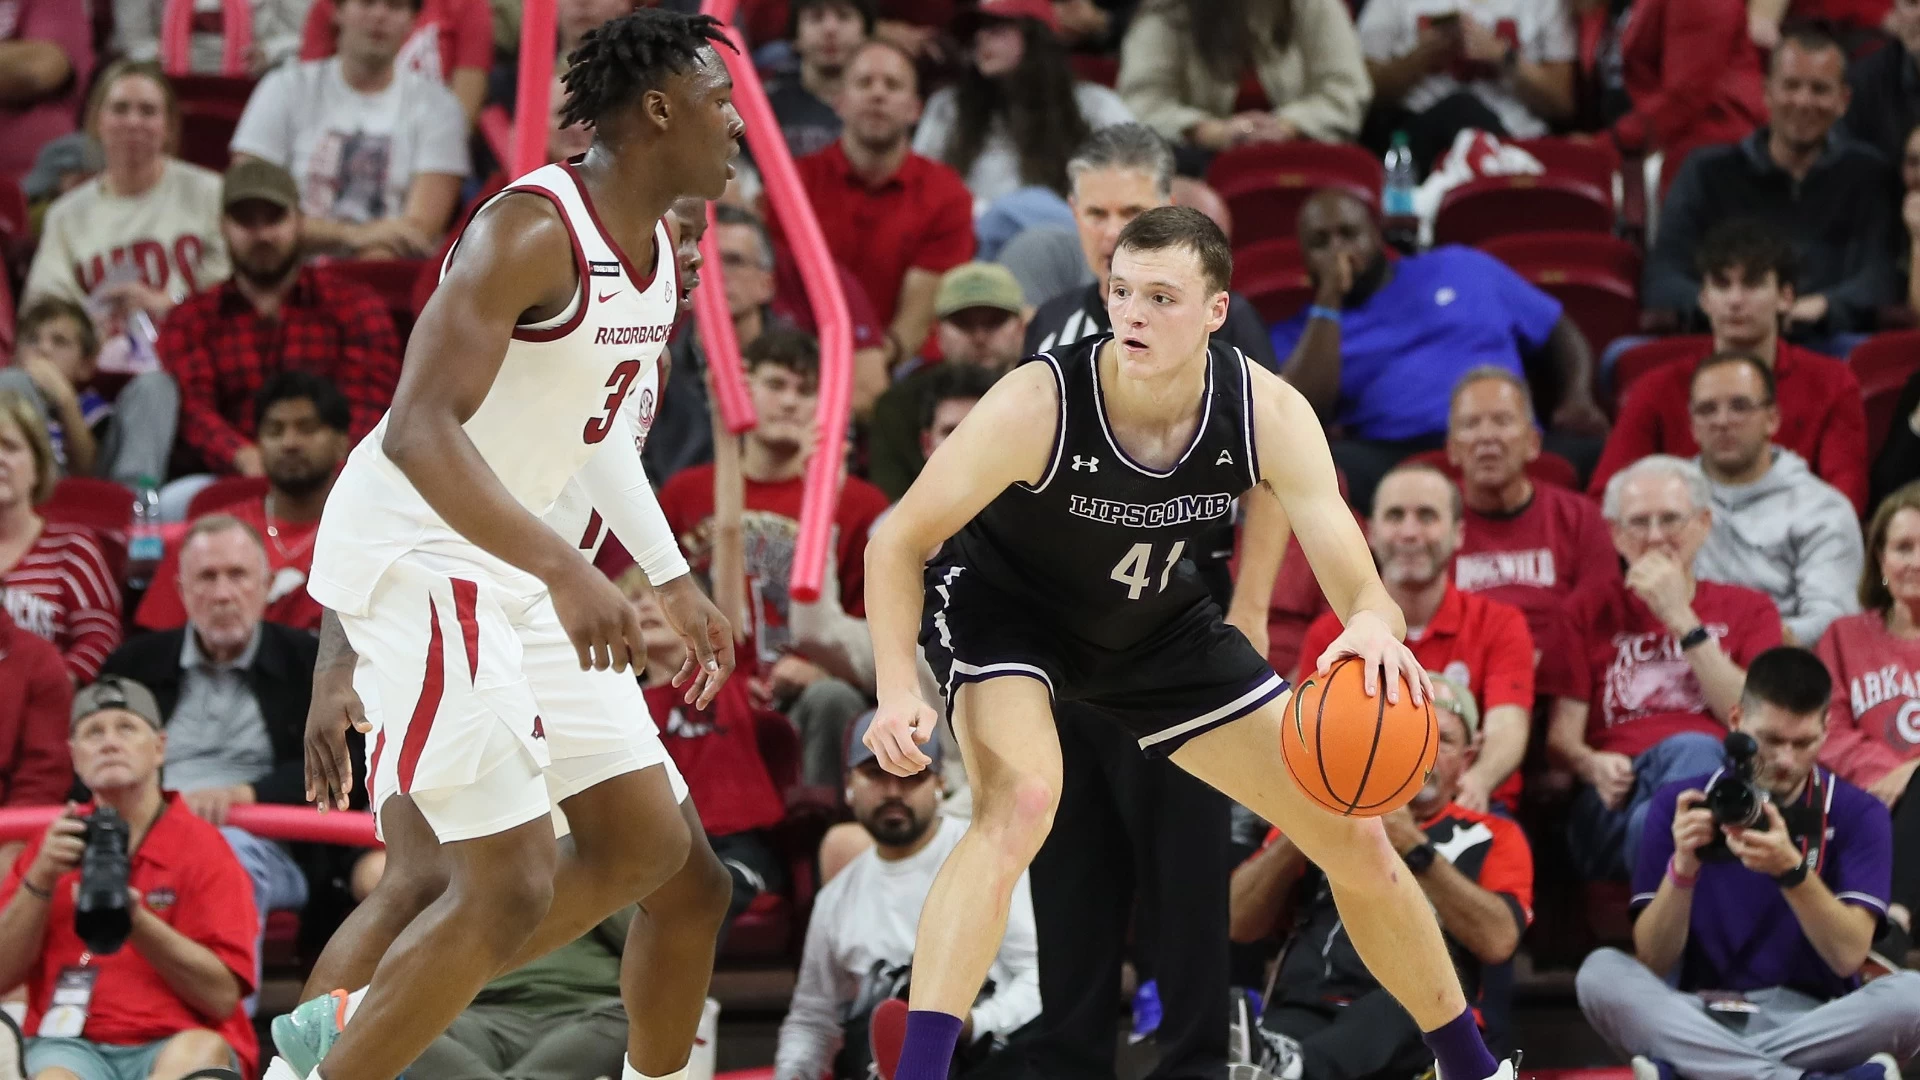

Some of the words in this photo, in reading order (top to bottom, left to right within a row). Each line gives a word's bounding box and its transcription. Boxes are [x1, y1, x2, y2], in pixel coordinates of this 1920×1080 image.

[583, 359, 640, 444] 3
[1069, 493, 1231, 528] LIPSCOMB
[1110, 539, 1186, 600] 41
[1851, 664, 1920, 719] ARKA
